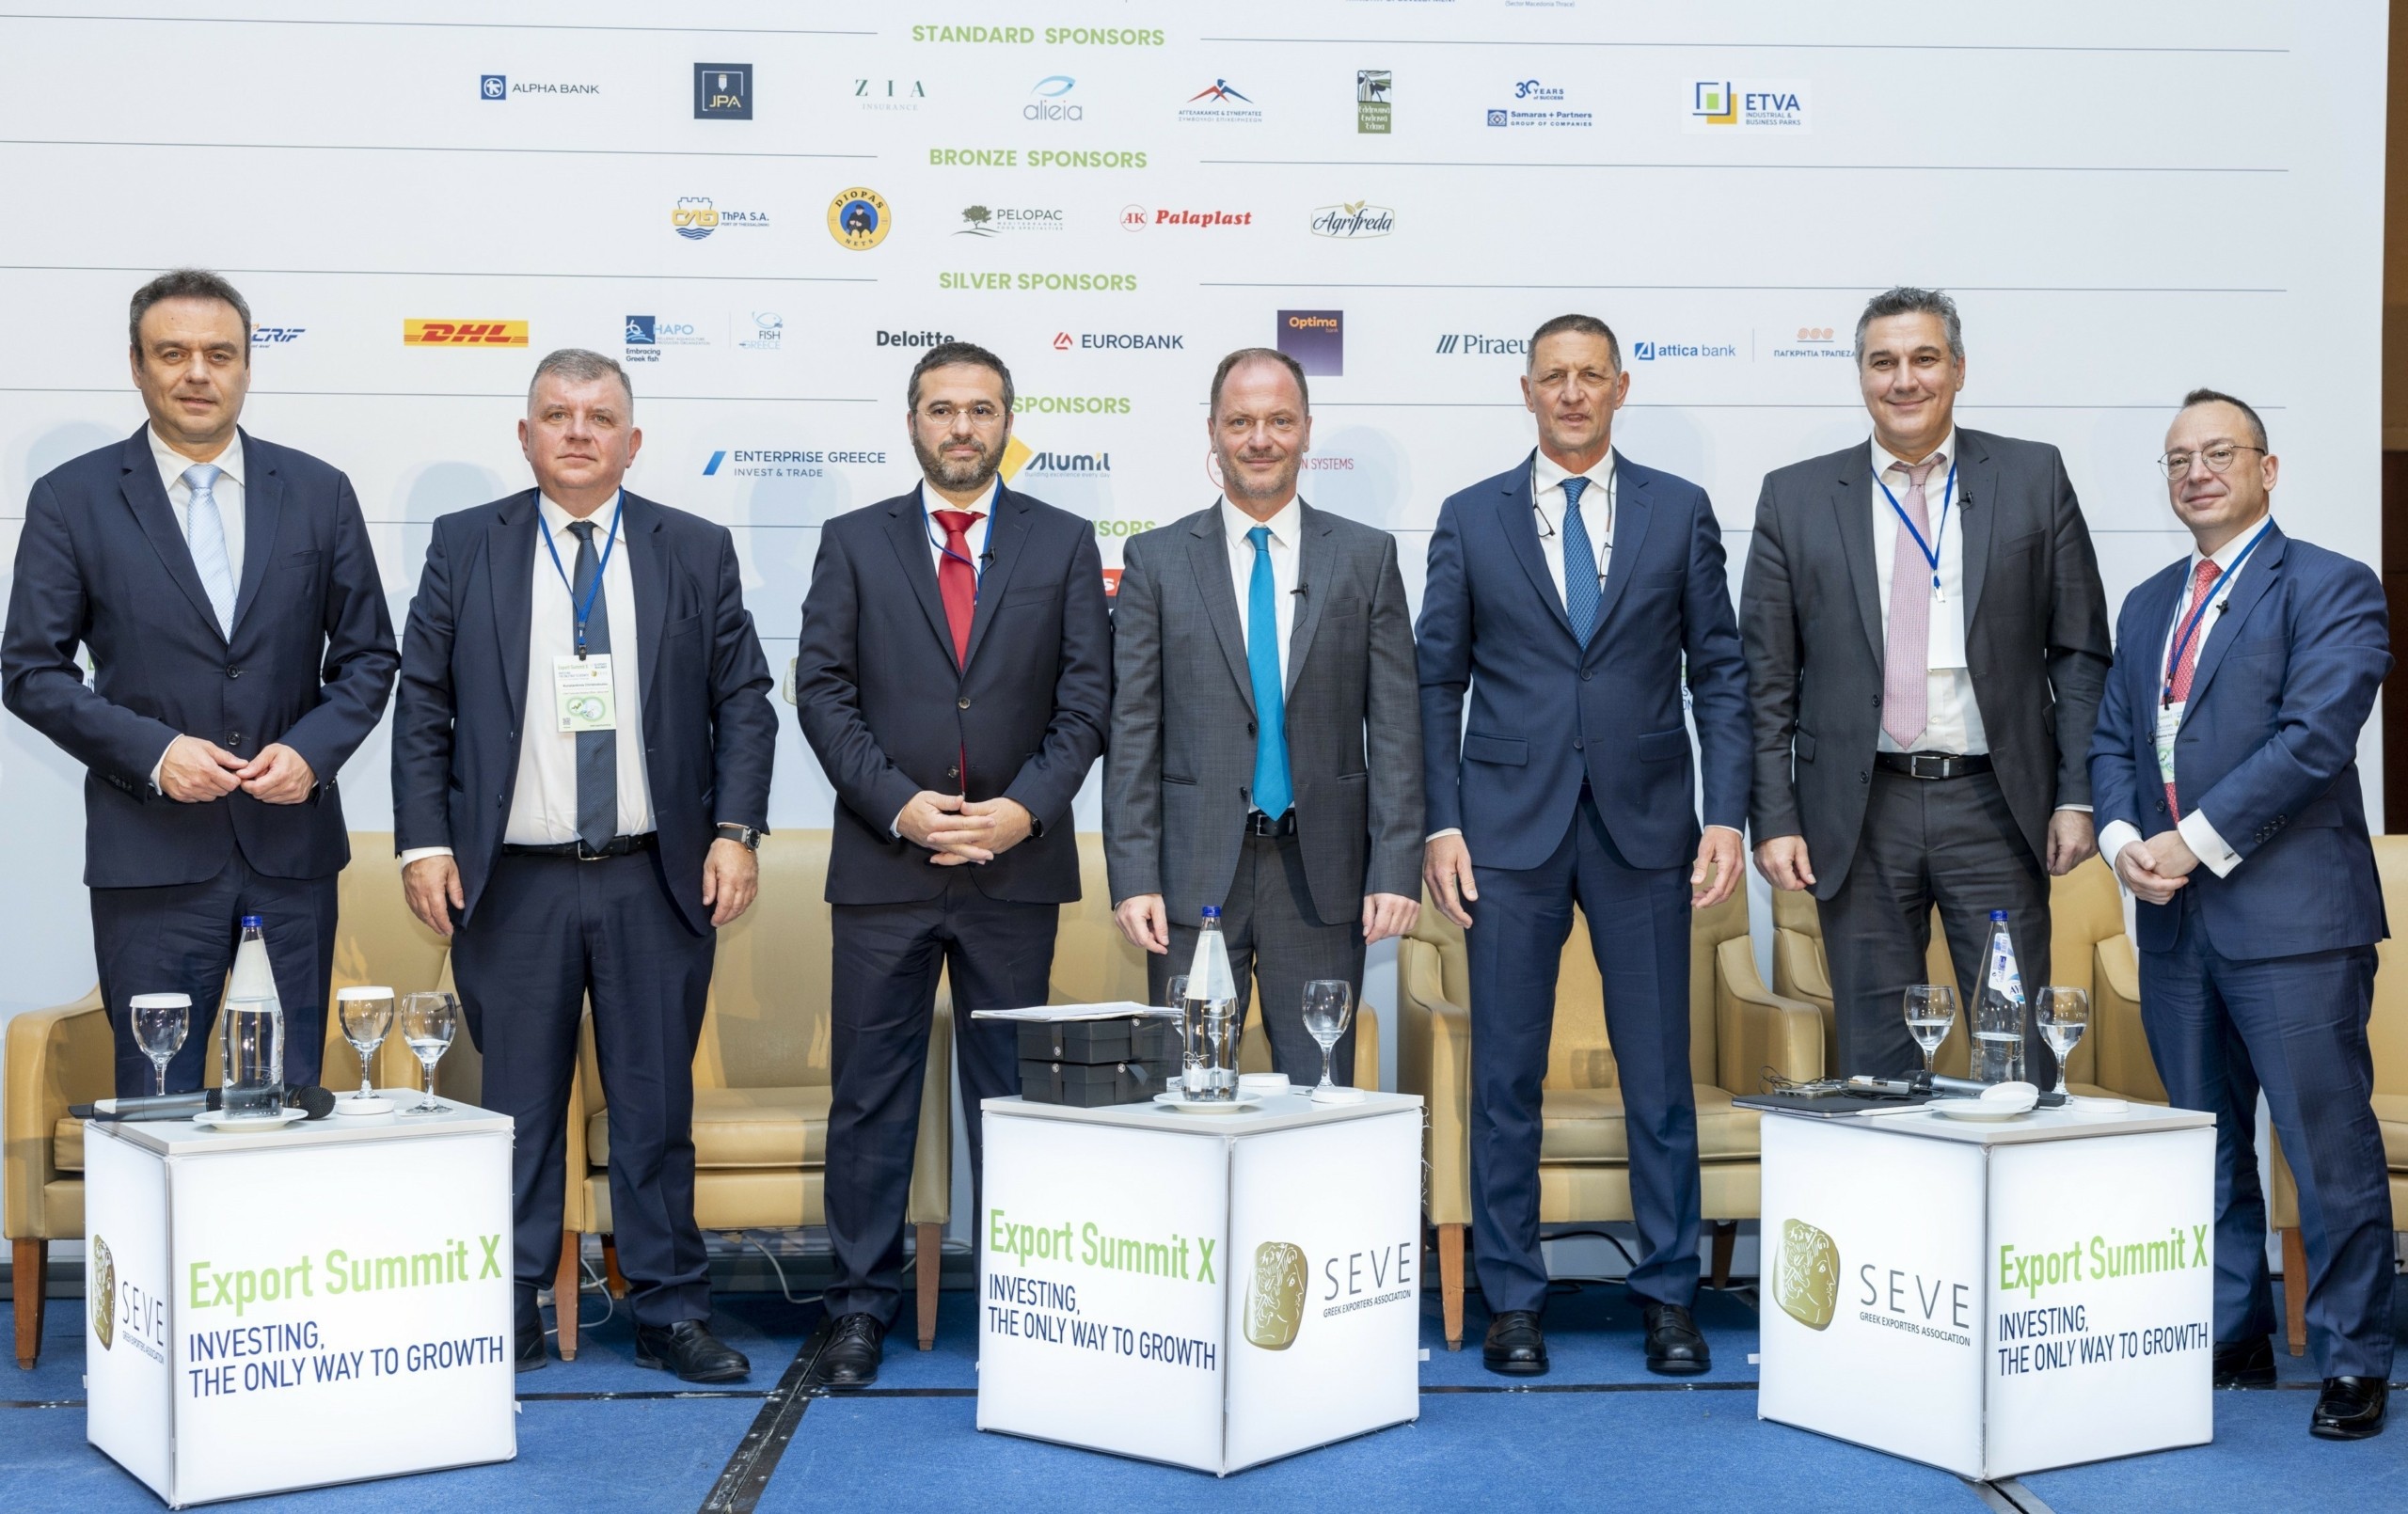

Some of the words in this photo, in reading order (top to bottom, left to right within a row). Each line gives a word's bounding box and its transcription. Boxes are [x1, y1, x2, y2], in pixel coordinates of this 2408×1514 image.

[912, 25, 1035, 44] STANDARD
[1045, 27, 1165, 46] SPONSORS
[513, 84, 557, 94] ALPHA
[561, 84, 600, 95] BANK
[709, 95, 742, 108] JPA
[1023, 100, 1084, 121] alieia
[1746, 94, 1801, 111] ETVA
[929, 150, 1018, 166] BRONZE
[1028, 150, 1148, 168] SPONSORS
[835, 191, 884, 210] DIOPAS
[721, 212, 747, 221] ThPA
[751, 213, 770, 222] S.A.
[997, 210, 1063, 221] PELOPAC
[1156, 210, 1253, 228] Palaplast
[1313, 209, 1393, 237] Agrifreda
[846, 238, 874, 246] NETS
[940, 273, 1012, 290] SILVER
[1018, 274, 1137, 292] SPONSORS
[654, 324, 694, 336] HAPO
[1290, 317, 1338, 329] Optima
[421, 323, 513, 343] DHL
[759, 331, 781, 340] FISH
[876, 331, 955, 347] Deloitte
[1083, 335, 1184, 350] EUROBANK
[744, 341, 781, 350] GREECE
[1464, 335, 1529, 355] Piraeu
[1658, 344, 1699, 356] attica
[1703, 344, 1736, 357] bank
[1013, 397, 1131, 414] SPONSORS
[735, 450, 824, 463] ENTERPRISE
[829, 452, 886, 464] GREECE
[1026, 452, 1111, 471] Alumil
[1311, 458, 1354, 470] SYSTEMS
[735, 468, 773, 477] INVEST
[990, 1208, 1074, 1267] Export
[1082, 1222, 1190, 1281] Summit
[1197, 1238, 1216, 1285] X
[2001, 1241, 2083, 1299] Export
[2090, 1227, 2185, 1280] Summit
[2193, 1224, 2209, 1268] X
[190, 1255, 313, 1317] Export
[325, 1238, 469, 1293] Summit
[479, 1235, 502, 1280] X
[1324, 1242, 1411, 1301] SEVE
[990, 1274, 1081, 1316] INVESTING,
[1323, 1306, 1341, 1318] GREEK
[1342, 1300, 1373, 1315] EXPORTERS
[1374, 1289, 1411, 1308] ASSOCIATION
[1860, 1264, 1970, 1330] SEVE
[122, 1281, 165, 1347] SEVE
[1999, 1304, 2089, 1342] INVESTING,
[989, 1307, 1020, 1337] THE
[1023, 1314, 1066, 1345] ONLY
[1071, 1322, 1109, 1353] WAY
[1113, 1327, 1134, 1356] TO
[1139, 1333, 1216, 1371] GROWTH
[1860, 1311, 1881, 1325] GREEK
[1882, 1316, 1921, 1336] EXPORTERS
[1921, 1324, 1971, 1348] ASSOCIATION
[190, 1320, 325, 1363] INVESTING,
[1999, 1346, 2030, 1377] THE
[2035, 1339, 2077, 1371] ONLY
[2080, 1333, 2115, 1364] WAY
[2119, 1332, 2137, 1358] TO
[2143, 1322, 2209, 1356] GROWTH
[189, 1366, 237, 1398] THE
[245, 1358, 307, 1392] ONLY
[313, 1351, 365, 1383] WAY
[371, 1347, 399, 1377] TO
[406, 1335, 504, 1372] GROWTH
